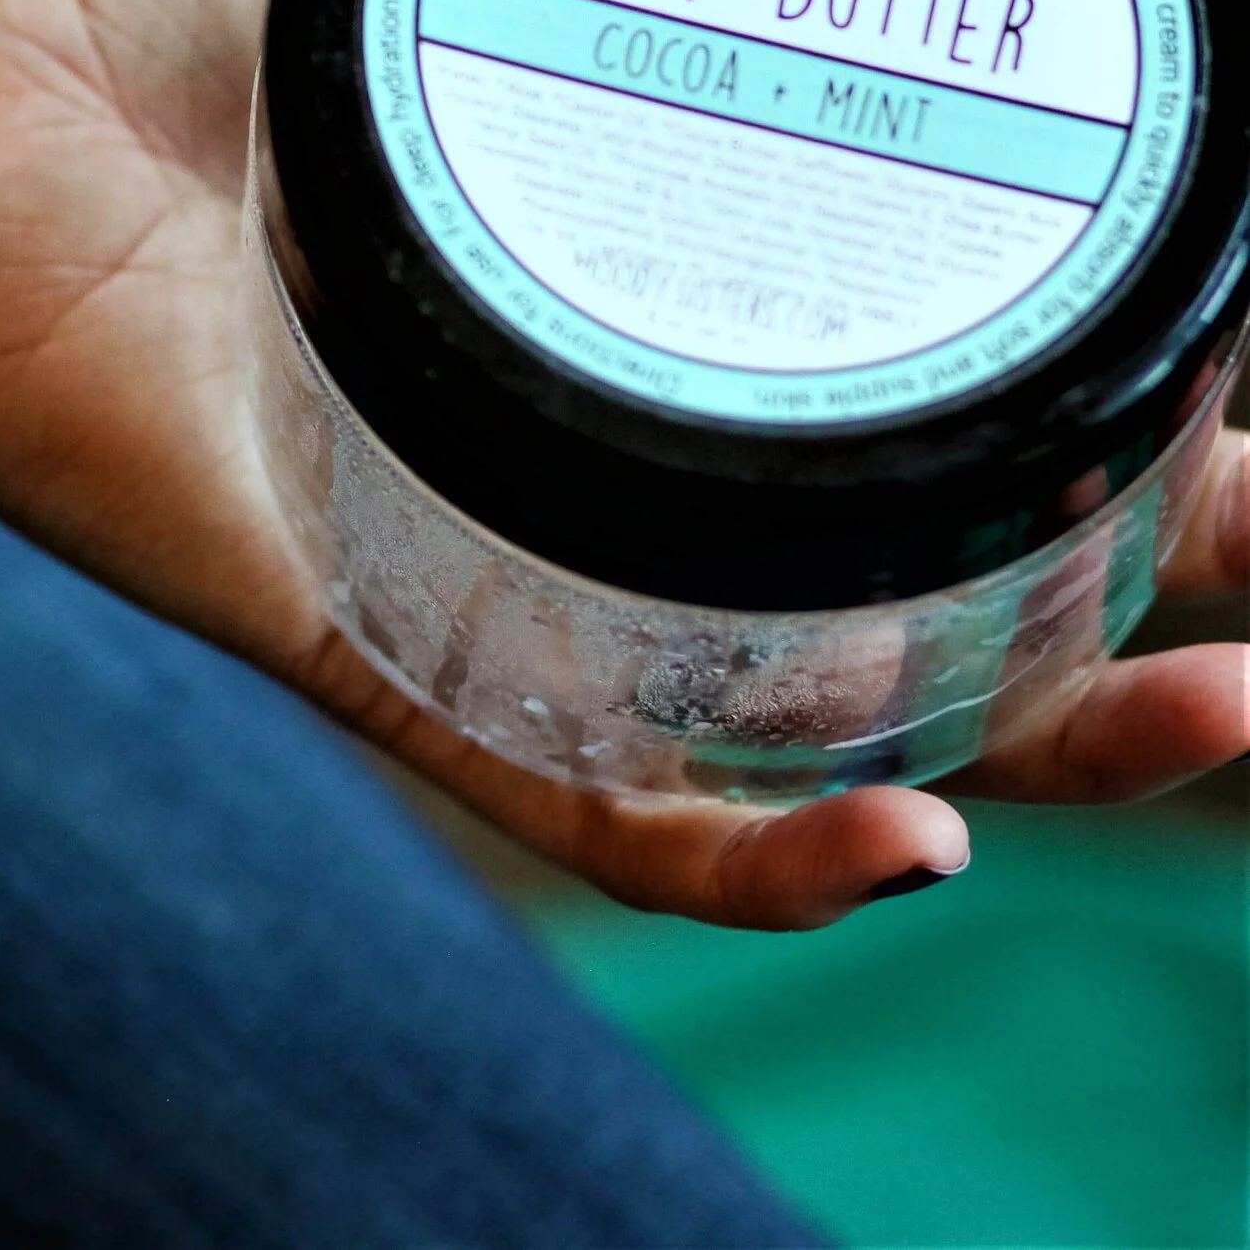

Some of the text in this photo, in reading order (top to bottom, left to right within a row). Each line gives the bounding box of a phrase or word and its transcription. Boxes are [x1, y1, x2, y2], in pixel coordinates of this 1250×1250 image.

[593, 22, 739, 102] COCOA
[818, 77, 933, 142] MINT
[1155, 3, 1179, 82] cream
[1155, 91, 1179, 119] to
